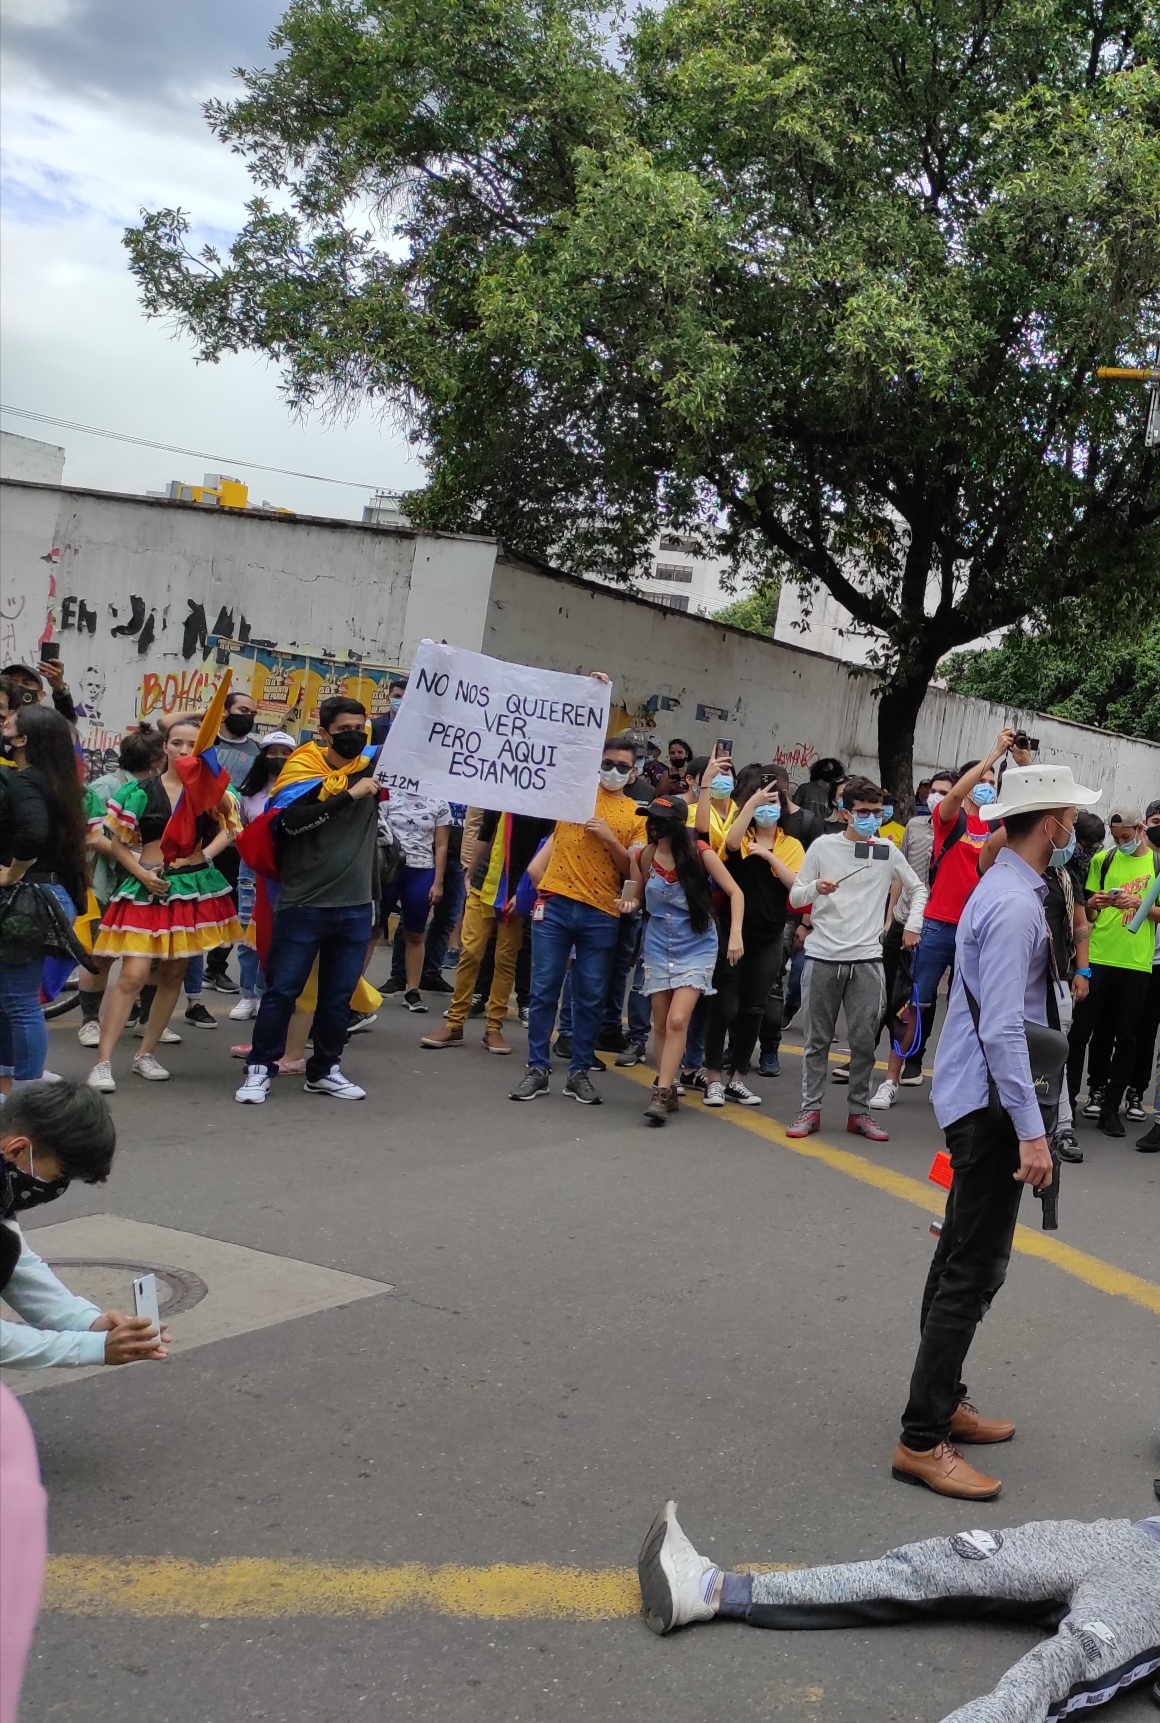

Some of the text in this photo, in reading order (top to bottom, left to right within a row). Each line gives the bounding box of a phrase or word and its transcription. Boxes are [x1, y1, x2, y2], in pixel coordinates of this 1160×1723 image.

[416, 668, 603, 729] NO NOS QUIEREN
[429, 722, 557, 767] PERO AQUI
[377, 771, 420, 792] #12M
[449, 752, 546, 790] ESTAMOS
